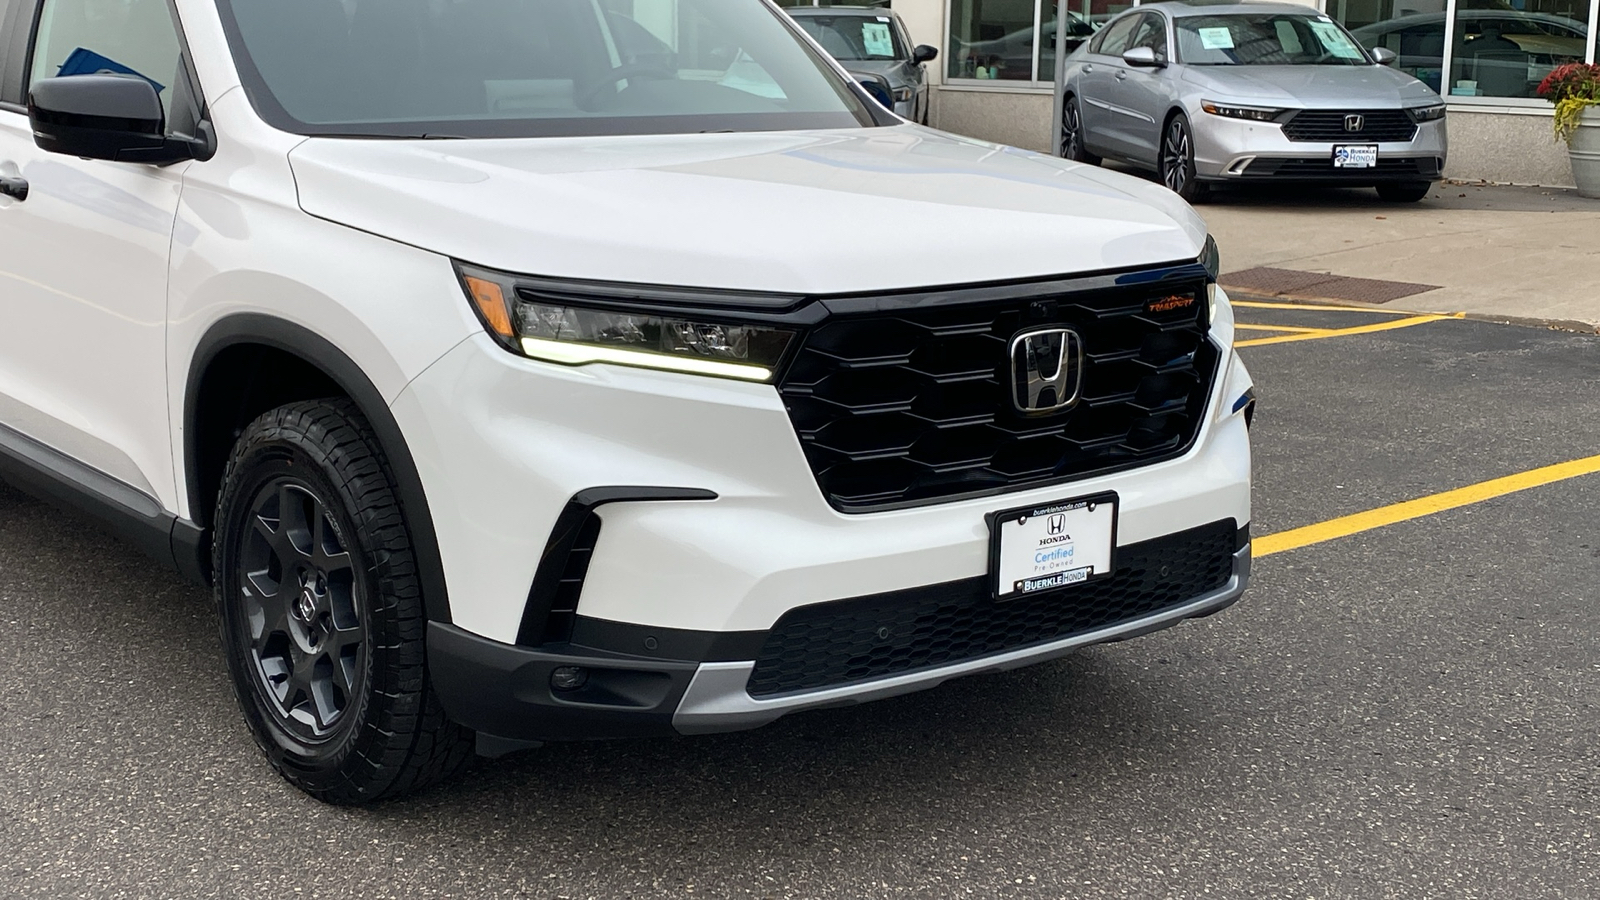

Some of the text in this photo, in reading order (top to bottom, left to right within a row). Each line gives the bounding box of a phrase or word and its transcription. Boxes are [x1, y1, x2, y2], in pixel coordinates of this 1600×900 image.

[1033, 501, 1087, 516] buerklehonda.com
[1039, 534, 1071, 545] HONDA
[1035, 546, 1074, 563] Certified
[1024, 576, 1062, 591] BUERKLE
[1062, 571, 1086, 584] HONDA
